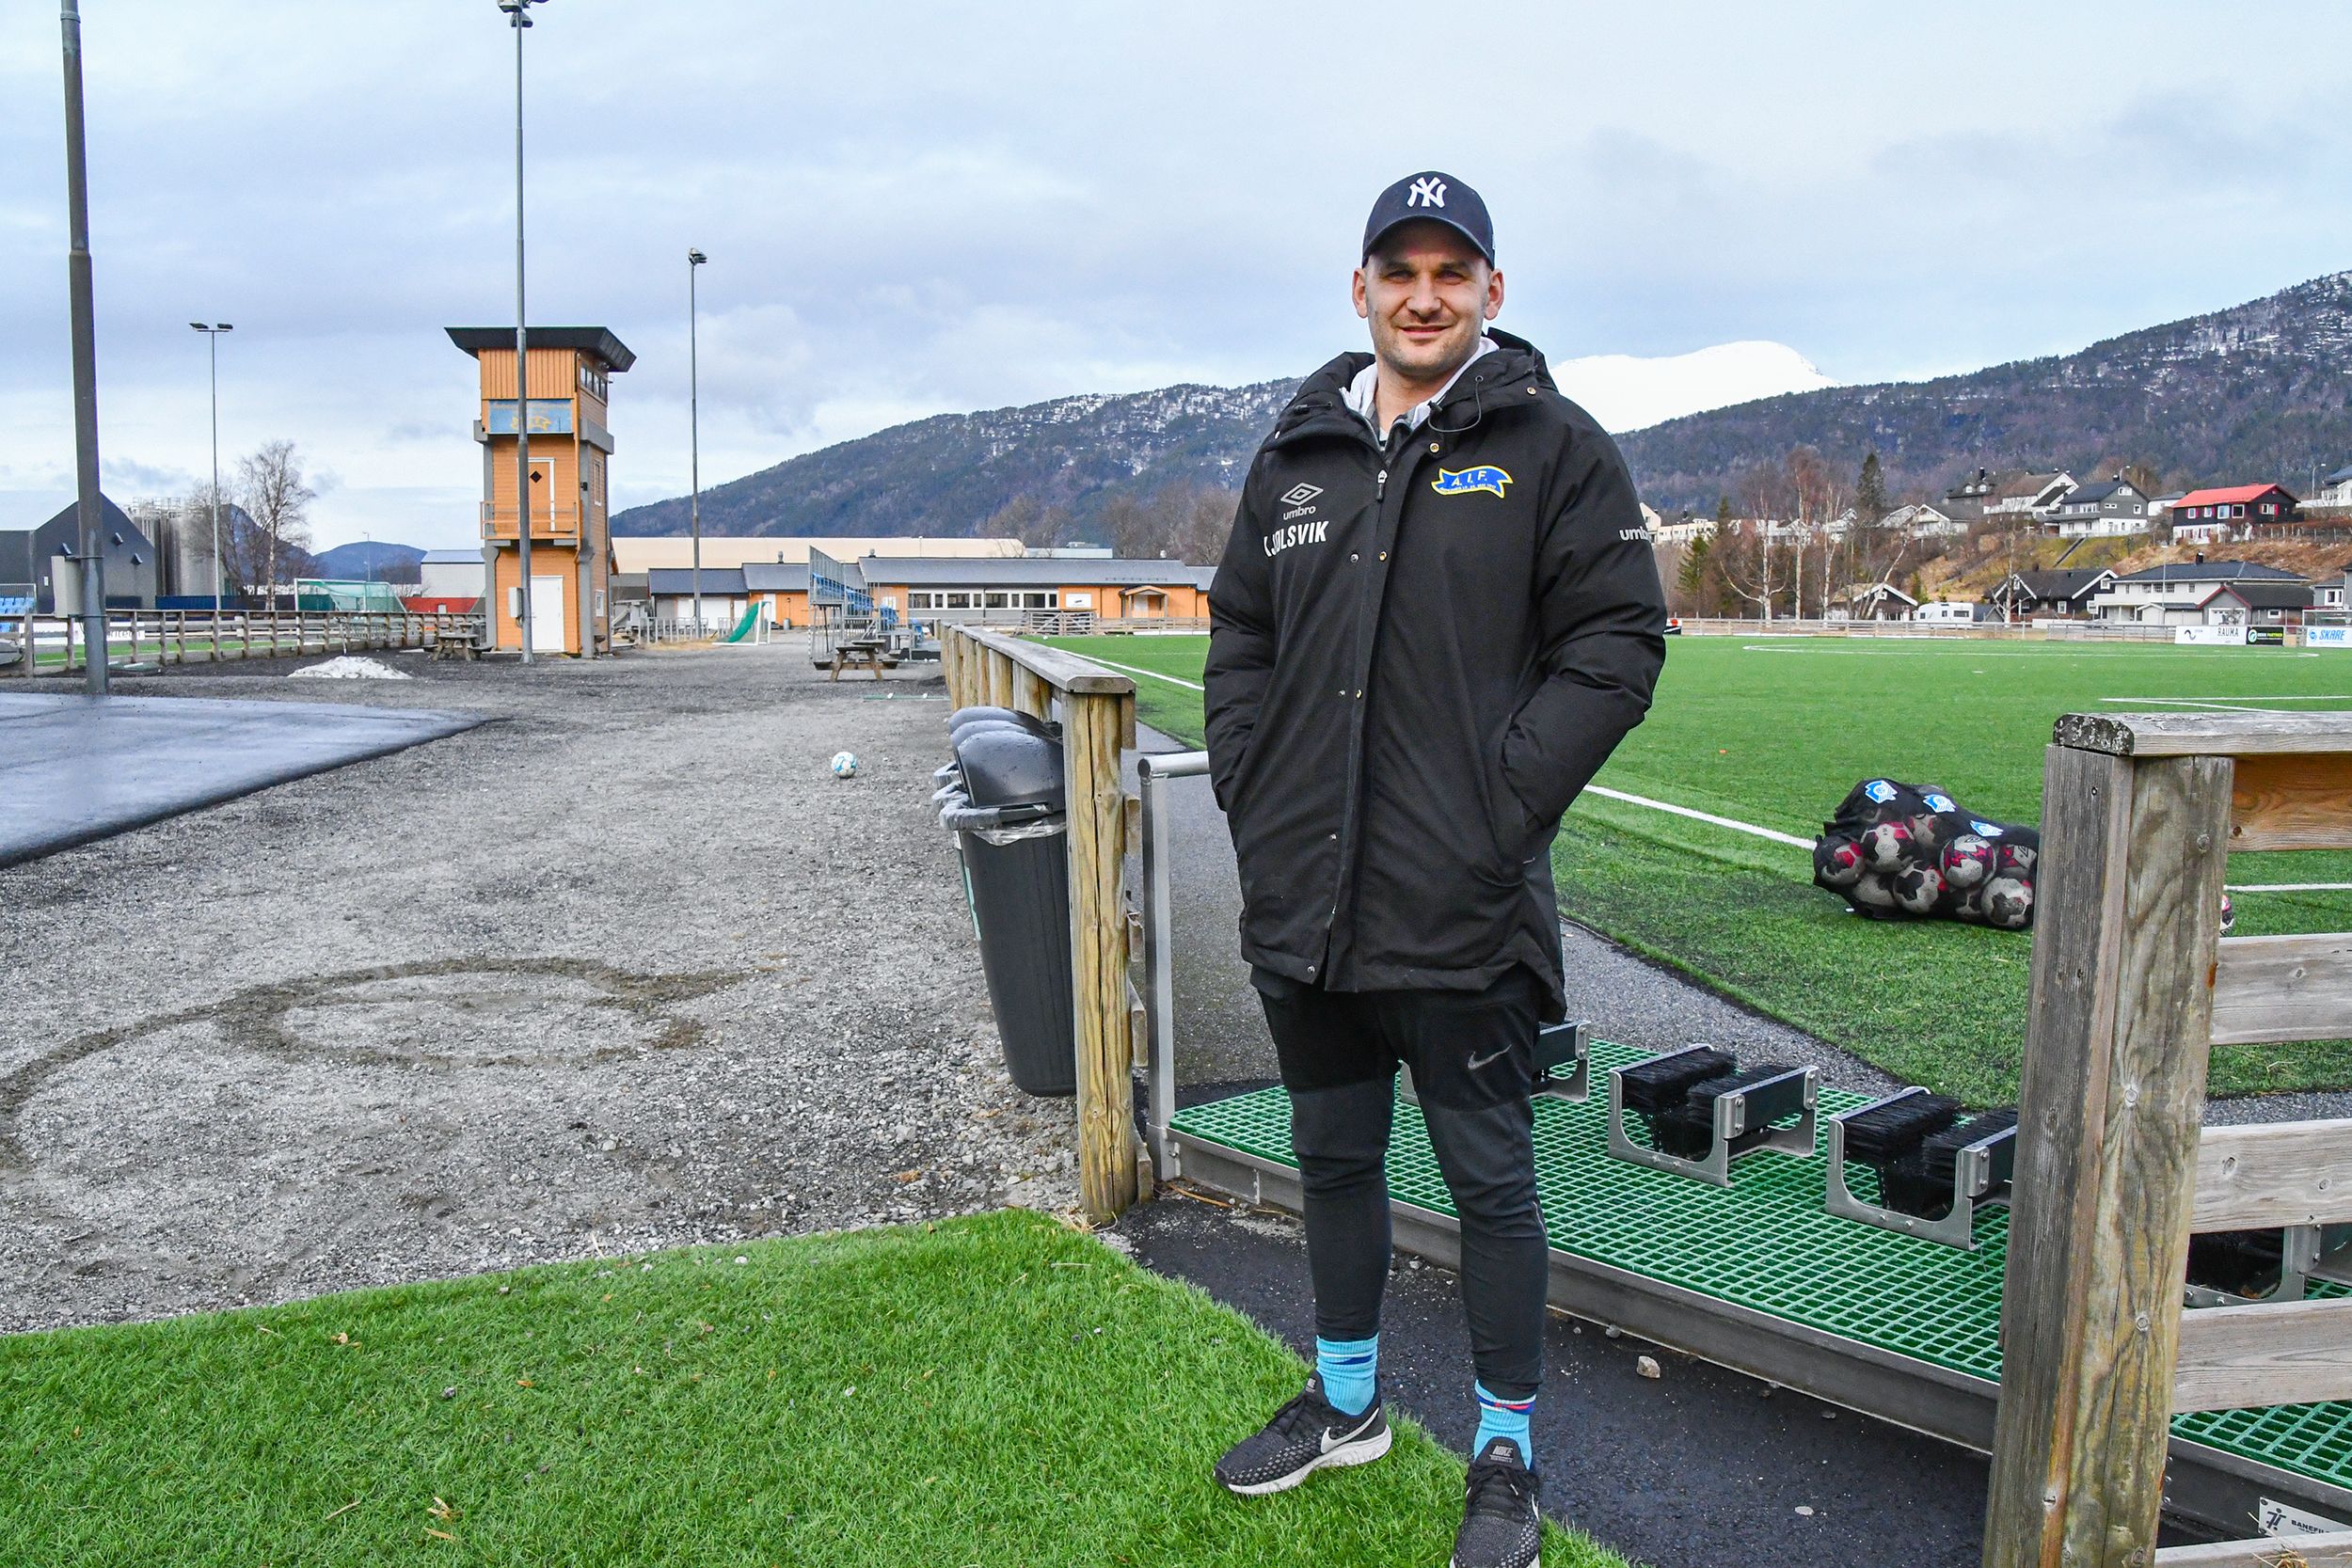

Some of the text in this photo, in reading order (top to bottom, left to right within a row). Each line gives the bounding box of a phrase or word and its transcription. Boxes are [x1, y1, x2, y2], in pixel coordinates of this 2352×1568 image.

[1406, 177, 1447, 208] NY
[1283, 506, 1316, 520] umbro
[1619, 526, 1651, 542] umb
[2217, 627, 2239, 637] RAUMA
[1492, 1445, 1514, 1457] NIKE
